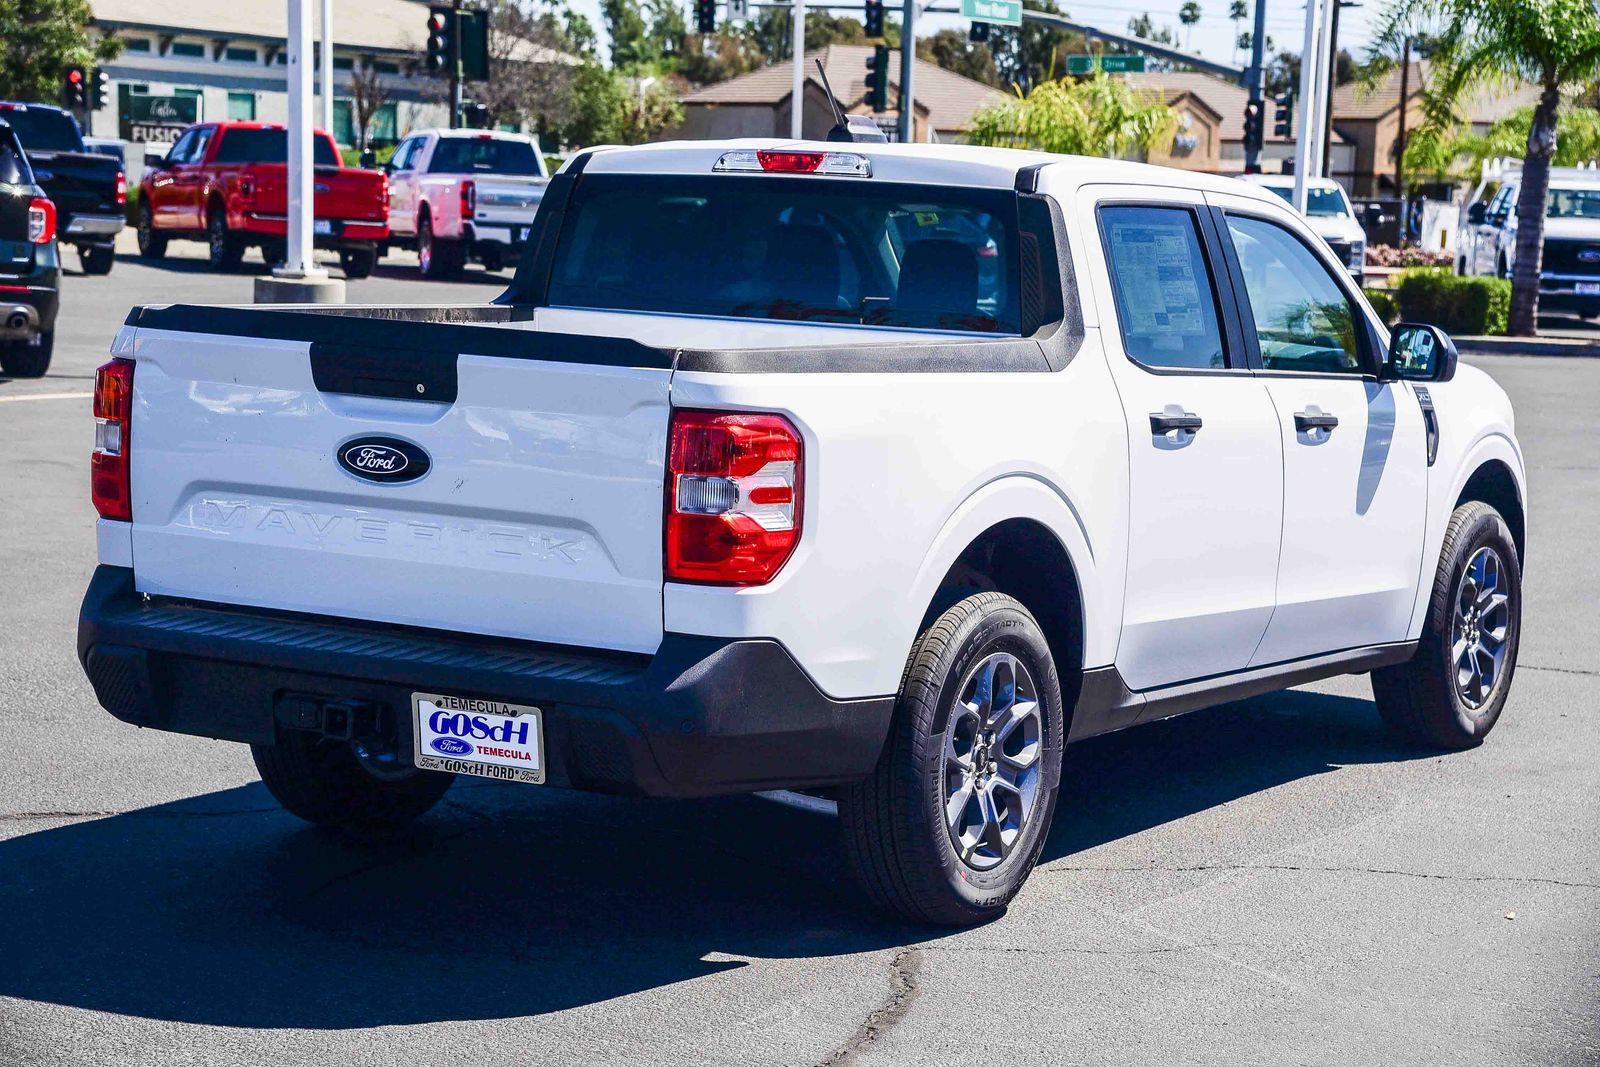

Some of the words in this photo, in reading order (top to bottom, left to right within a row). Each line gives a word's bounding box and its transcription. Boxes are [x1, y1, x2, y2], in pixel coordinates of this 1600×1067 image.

[356, 447, 396, 470] Ford
[204, 500, 585, 564] MAVERICK
[443, 696, 510, 716] TEMECULA
[440, 739, 464, 753] Ford
[476, 745, 532, 761] TEMECULA
[419, 757, 440, 769] Ford
[486, 765, 515, 780] FORD
[519, 770, 540, 782] Ford
